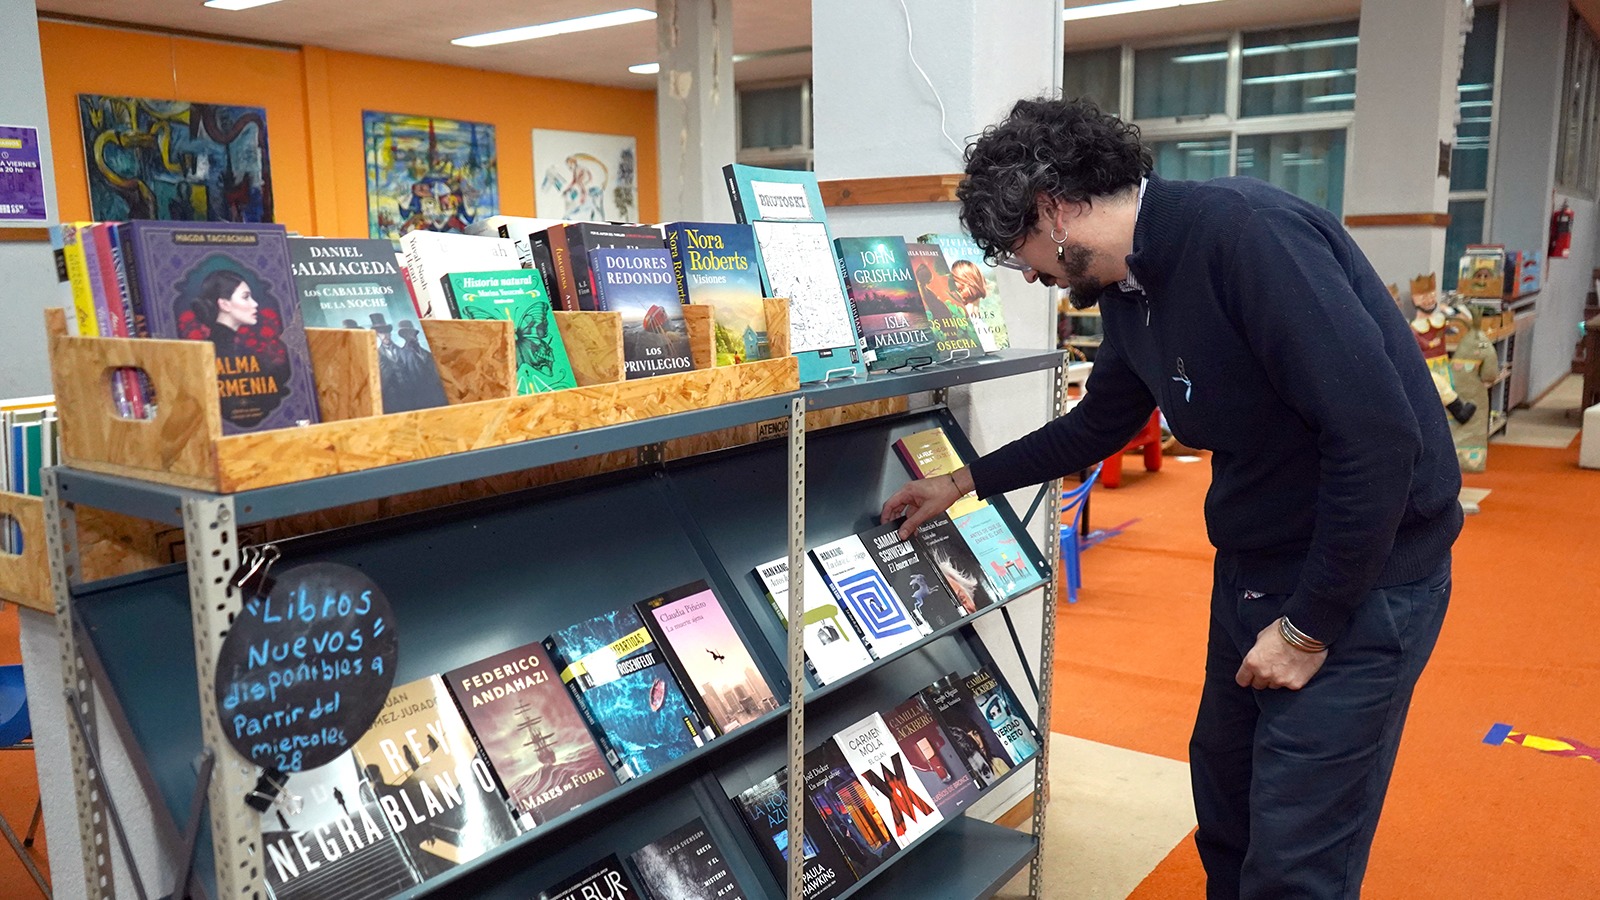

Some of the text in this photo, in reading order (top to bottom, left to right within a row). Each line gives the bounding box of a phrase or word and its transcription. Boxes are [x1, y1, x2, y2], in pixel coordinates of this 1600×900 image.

[175, 234, 256, 243] MAGDA TAGTACHIAN
[684, 229, 724, 249] Nora
[310, 246, 363, 258] DANIEL
[688, 251, 748, 270] Roberts
[860, 251, 895, 267] JOHN
[605, 256, 667, 269] DOLORES
[668, 231, 686, 304] Nora Roberts
[417, 264, 428, 290] Noah
[463, 275, 532, 288] Historia natural
[606, 272, 672, 284] REDONDO
[693, 274, 727, 284] Visiones
[854, 268, 913, 284] GRISHAM
[304, 285, 394, 297] LOS CABALLEROS
[838, 257, 862, 334] JOHN GRISHAM
[320, 298, 388, 310] DE LA NOCHE
[884, 316, 910, 329] ISLA
[942, 318, 968, 328] HIJOS
[971, 311, 995, 319] OLES
[874, 330, 929, 348] MALDITA
[936, 339, 977, 351] OSECHA
[645, 347, 662, 356] LOS
[216, 355, 260, 375] ALMA
[624, 356, 691, 373] PRIVILEGIOS
[217, 376, 278, 398] RMENIA
[873, 529, 902, 550] SAMANT
[879, 540, 914, 563] SCHWEBLIN
[888, 562, 896, 573] El
[660, 602, 707, 622] Claudia Piñeiro
[674, 619, 691, 630] muerte
[692, 615, 704, 623] ajena
[611, 634, 645, 655] PARTIDAS
[617, 652, 656, 675] ROSENFELDT
[223, 656, 384, 710] disponibles a
[462, 655, 540, 692] FEDERICO
[966, 672, 991, 689] CAMILLA
[471, 670, 549, 708] ANDAHAZI
[971, 678, 998, 697] ÄCKBERG
[309, 692, 340, 720] del
[383, 692, 409, 708] UAN
[369, 696, 438, 731] MEZ-JURADO
[889, 702, 924, 728] CAMILLA
[897, 712, 933, 742] ÄCKBERG
[994, 719, 1020, 738] VERDAD
[1006, 728, 1024, 743] RETO
[251, 727, 348, 758] miercoles
[379, 719, 449, 776] REY
[848, 728, 881, 751] CARMEN
[859, 739, 884, 757] MOLA
[275, 750, 303, 772] 28
[873, 751, 887, 763] CLAN
[812, 764, 830, 777] Dicker
[380, 757, 496, 834] BLANO
[521, 785, 563, 811] MARES
[570, 767, 605, 788] FURIA
[933, 788, 949, 802] UEÑOS
[749, 790, 788, 821] LA HOR
[767, 803, 788, 829] AZU
[267, 800, 384, 883] NEGRA
[667, 830, 704, 855] LENA SVENSSON
[695, 843, 712, 856] GRETA
[711, 857, 720, 865] EL
[703, 869, 727, 887] MISTERIO
[803, 863, 826, 884] PAULA
[803, 868, 836, 897] HAWKINS
[717, 883, 735, 897] DE LOS
